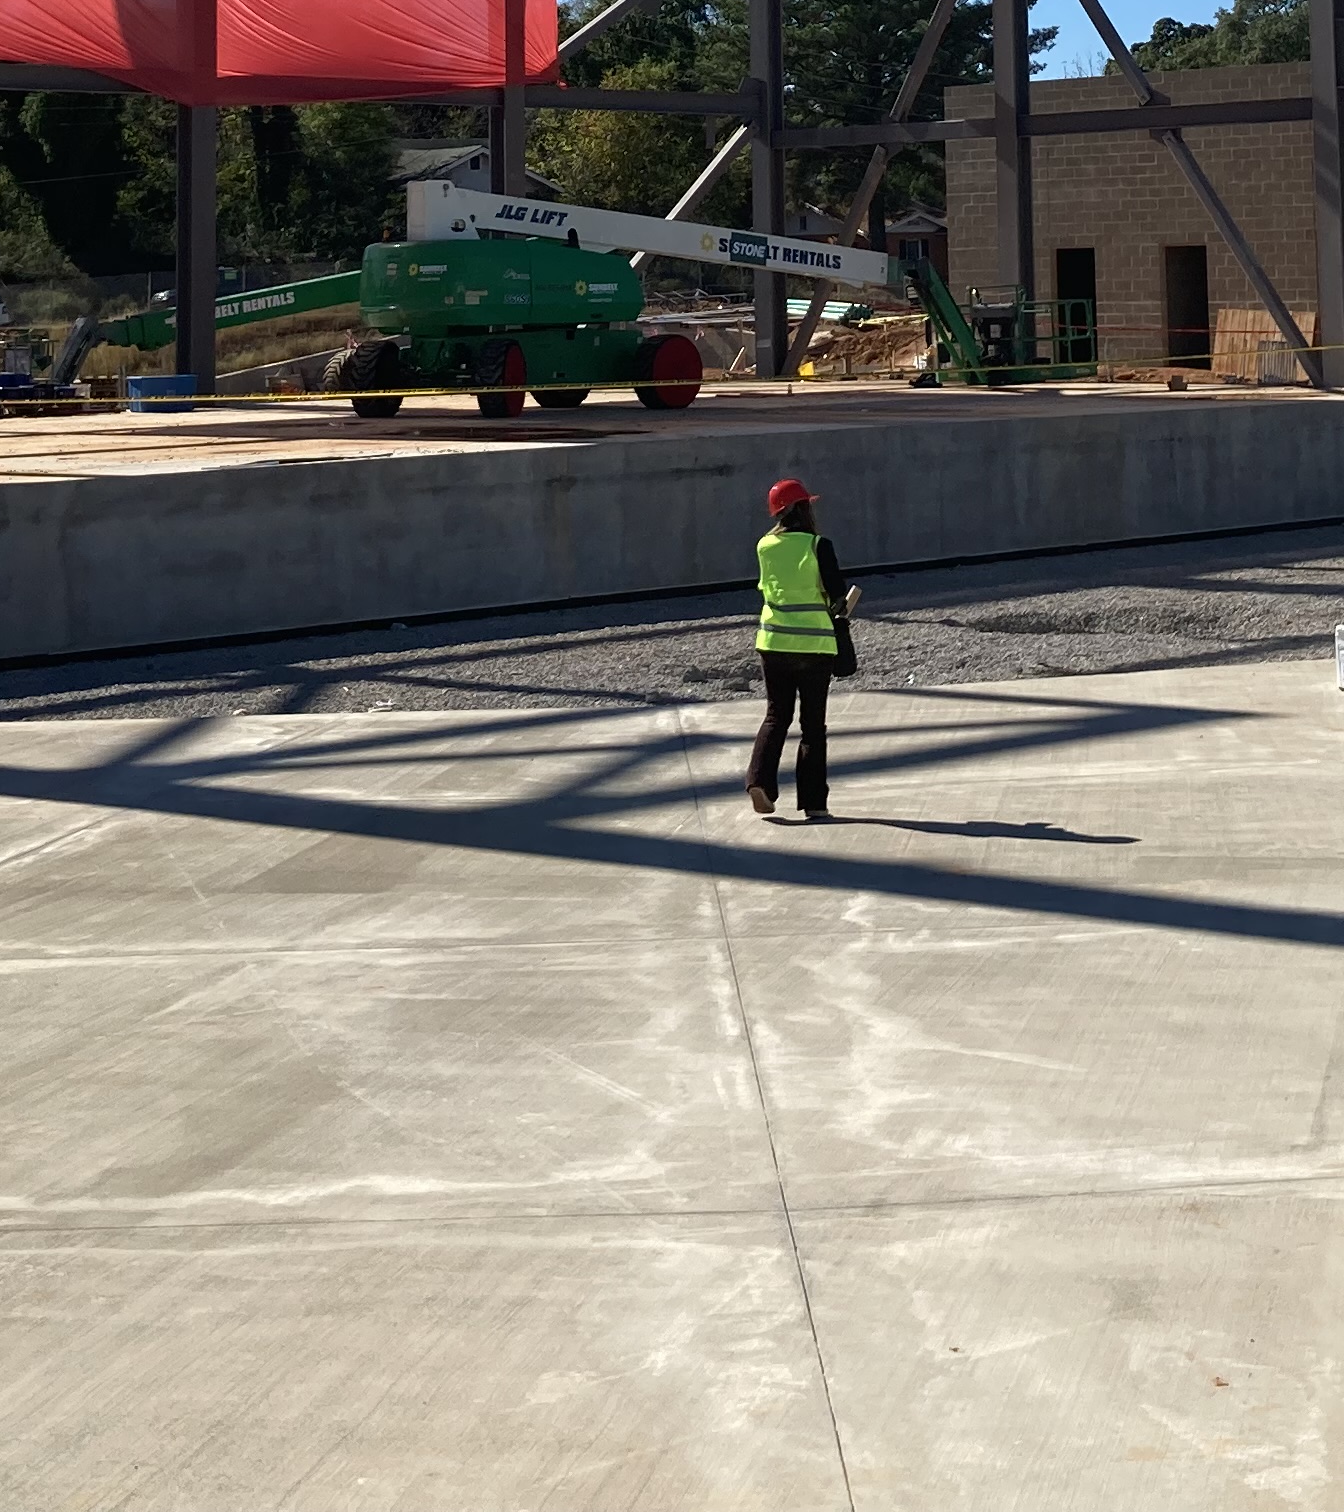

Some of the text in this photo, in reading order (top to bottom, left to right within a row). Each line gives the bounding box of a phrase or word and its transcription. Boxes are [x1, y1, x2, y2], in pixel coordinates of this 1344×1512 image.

[495, 204, 568, 226] JLG LIFT
[731, 241, 766, 258] STONE
[783, 247, 842, 270] RENTALS
[215, 291, 295, 318] BELT RENTALS
